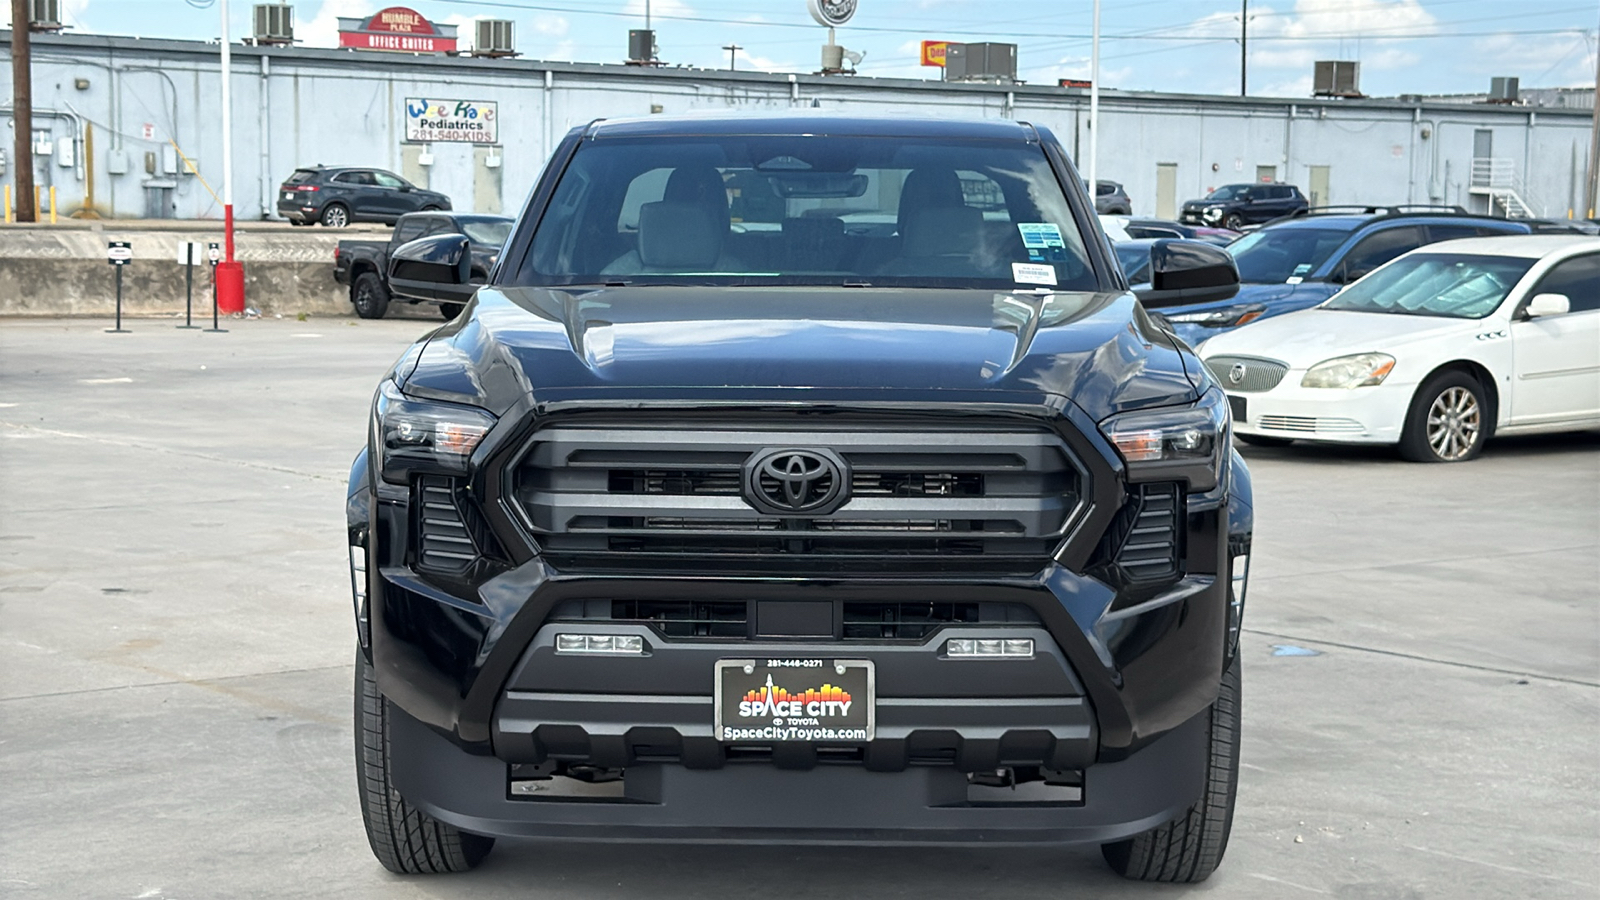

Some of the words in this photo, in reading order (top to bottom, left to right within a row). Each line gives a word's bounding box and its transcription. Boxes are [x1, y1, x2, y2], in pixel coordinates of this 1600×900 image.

[381, 12, 421, 26] HUMBLE
[389, 23, 412, 32] PLAZA
[368, 34, 401, 49] OFFICE
[401, 37, 434, 51] SUITES
[408, 98, 450, 118] Wee
[453, 101, 495, 121] Kare
[420, 118, 484, 130] Pediatrics
[412, 129, 492, 142] 281-540-KIDS
[738, 700, 803, 717] SPACE
[806, 700, 852, 717] CITY
[786, 717, 820, 726] TOYOTA
[723, 726, 867, 741] SpaceCityToyota.com
